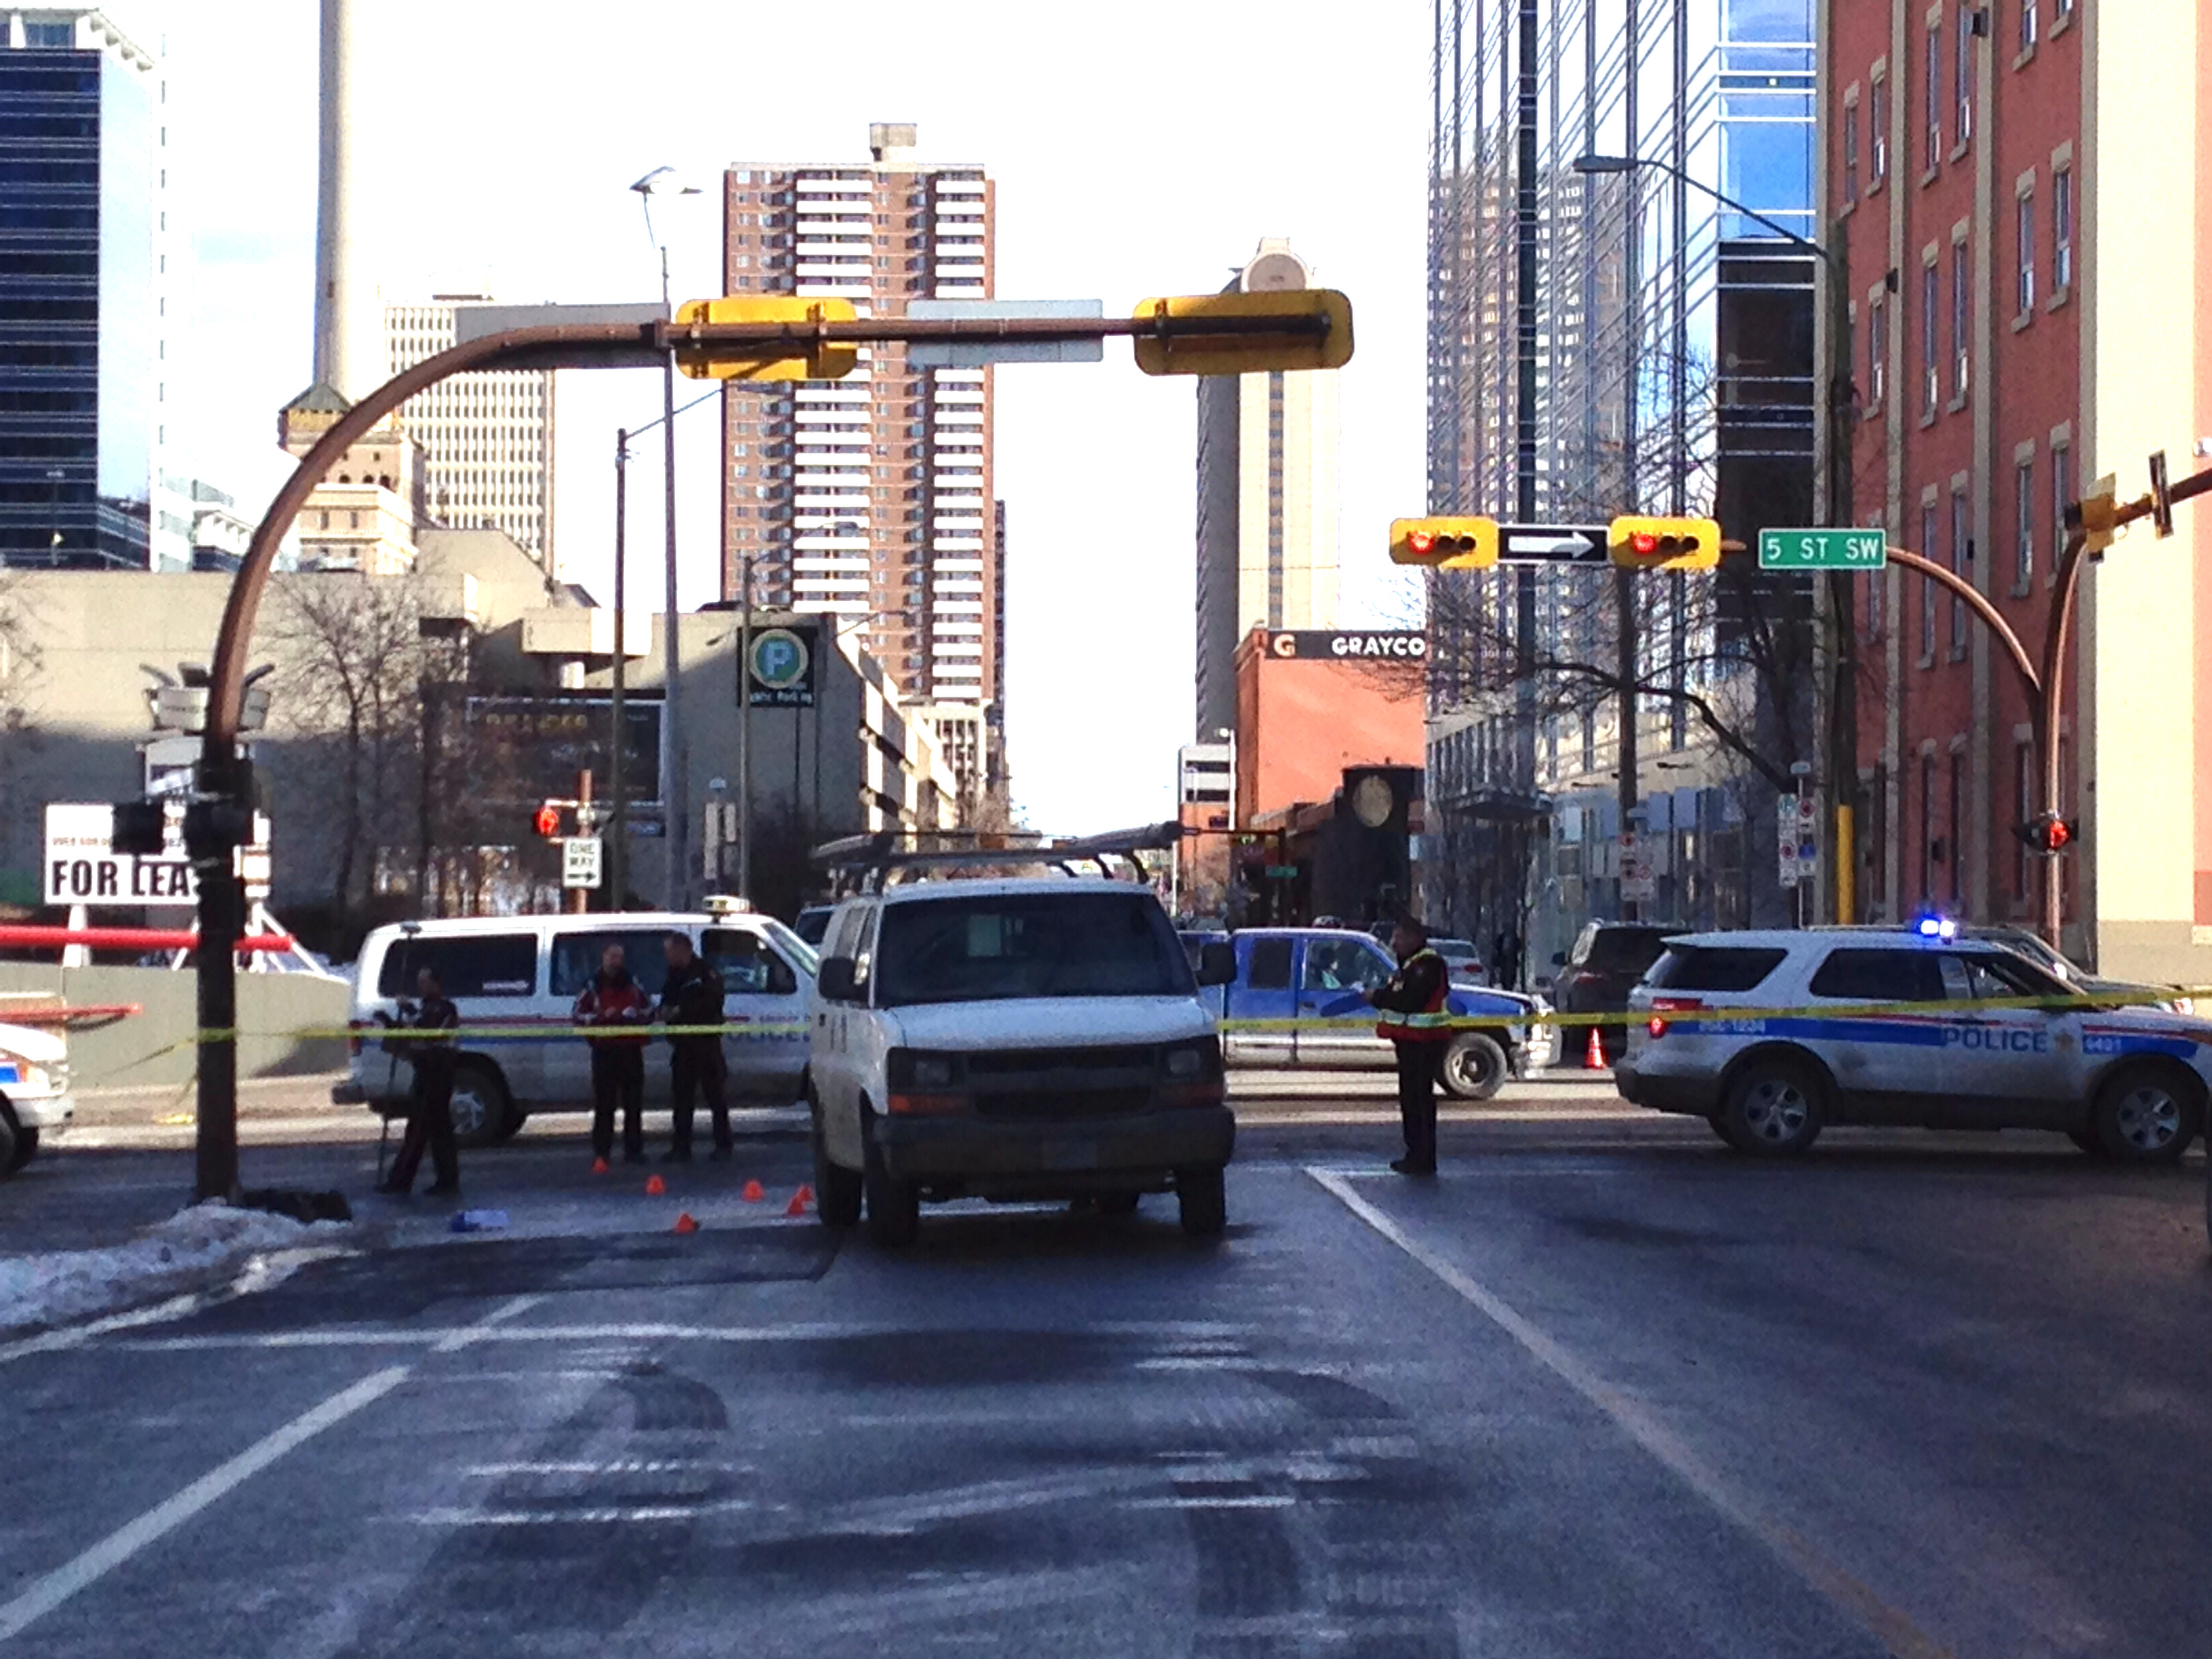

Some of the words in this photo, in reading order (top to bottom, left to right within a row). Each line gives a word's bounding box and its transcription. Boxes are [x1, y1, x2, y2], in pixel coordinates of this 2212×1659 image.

[1766, 537, 1782, 560] 5
[1799, 537, 1830, 560] ST
[1845, 537, 1879, 560] SW
[1331, 636, 1426, 656] GRAYCO
[766, 641, 793, 676] P
[569, 842, 596, 854] ONE
[569, 857, 596, 867] WAY
[52, 860, 119, 897] FOR
[131, 861, 191, 897] LEA
[1942, 1025, 2049, 1053] POLICE
